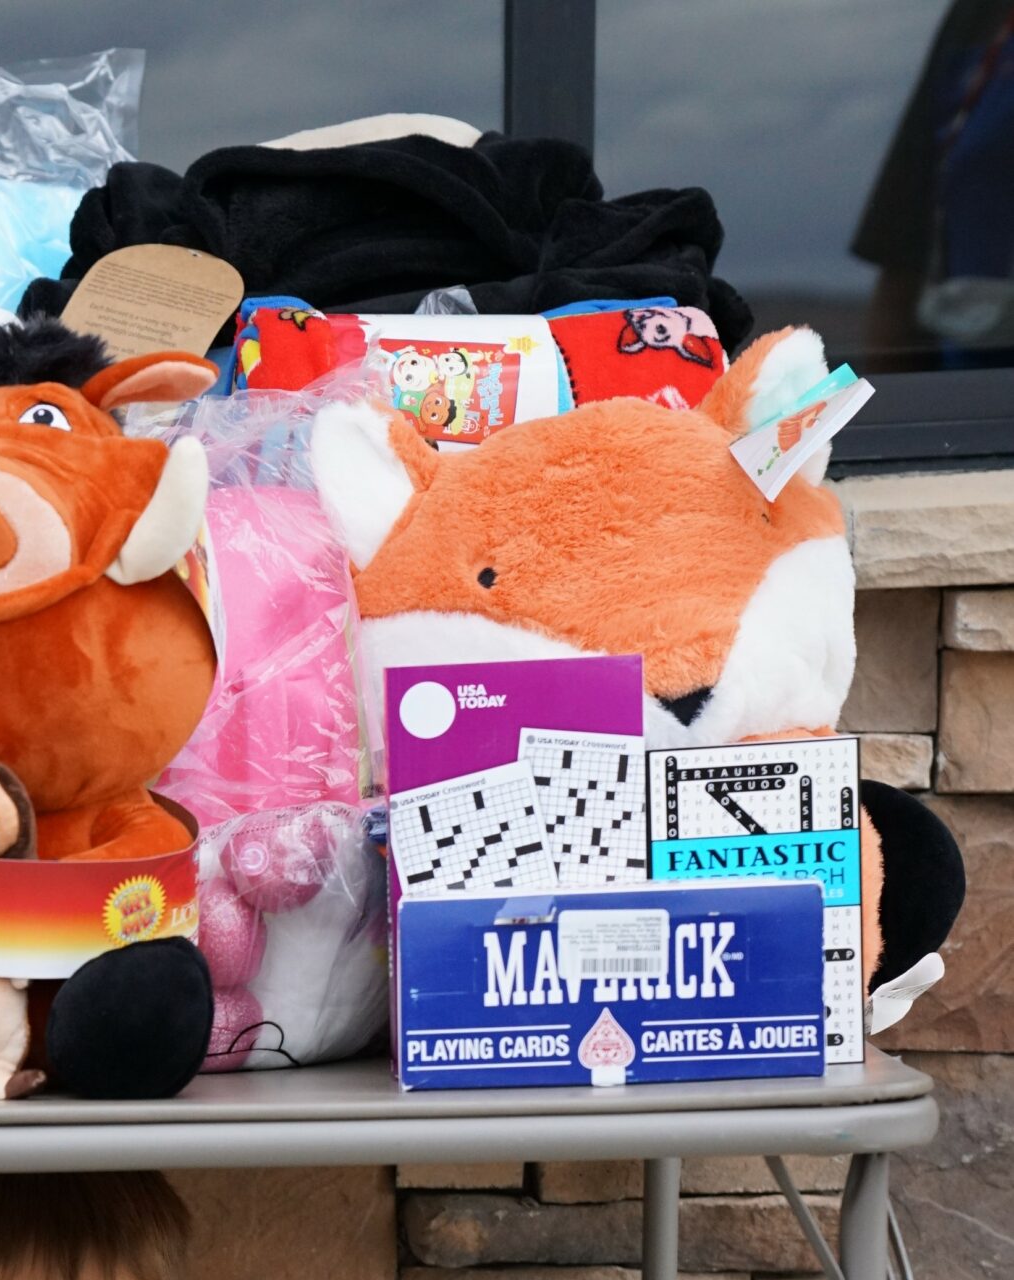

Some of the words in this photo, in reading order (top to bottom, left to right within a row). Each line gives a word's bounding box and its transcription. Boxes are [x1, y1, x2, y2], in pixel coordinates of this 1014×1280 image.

[457, 684, 487, 698] USA
[458, 695, 507, 709] TODAY
[554, 738, 579, 747] TODAY
[582, 739, 627, 750] Crossword
[401, 798, 415, 807] USA
[416, 791, 441, 802] TODAY
[443, 778, 486, 795] Crossword
[667, 841, 846, 872] FANTASTIC
[407, 1037, 494, 1063] PLAYING
[499, 1034, 570, 1059] CARDS
[641, 1028, 723, 1053] CARTES
[728, 1023, 744, 1050] À
[749, 1025, 817, 1049] JOUER
